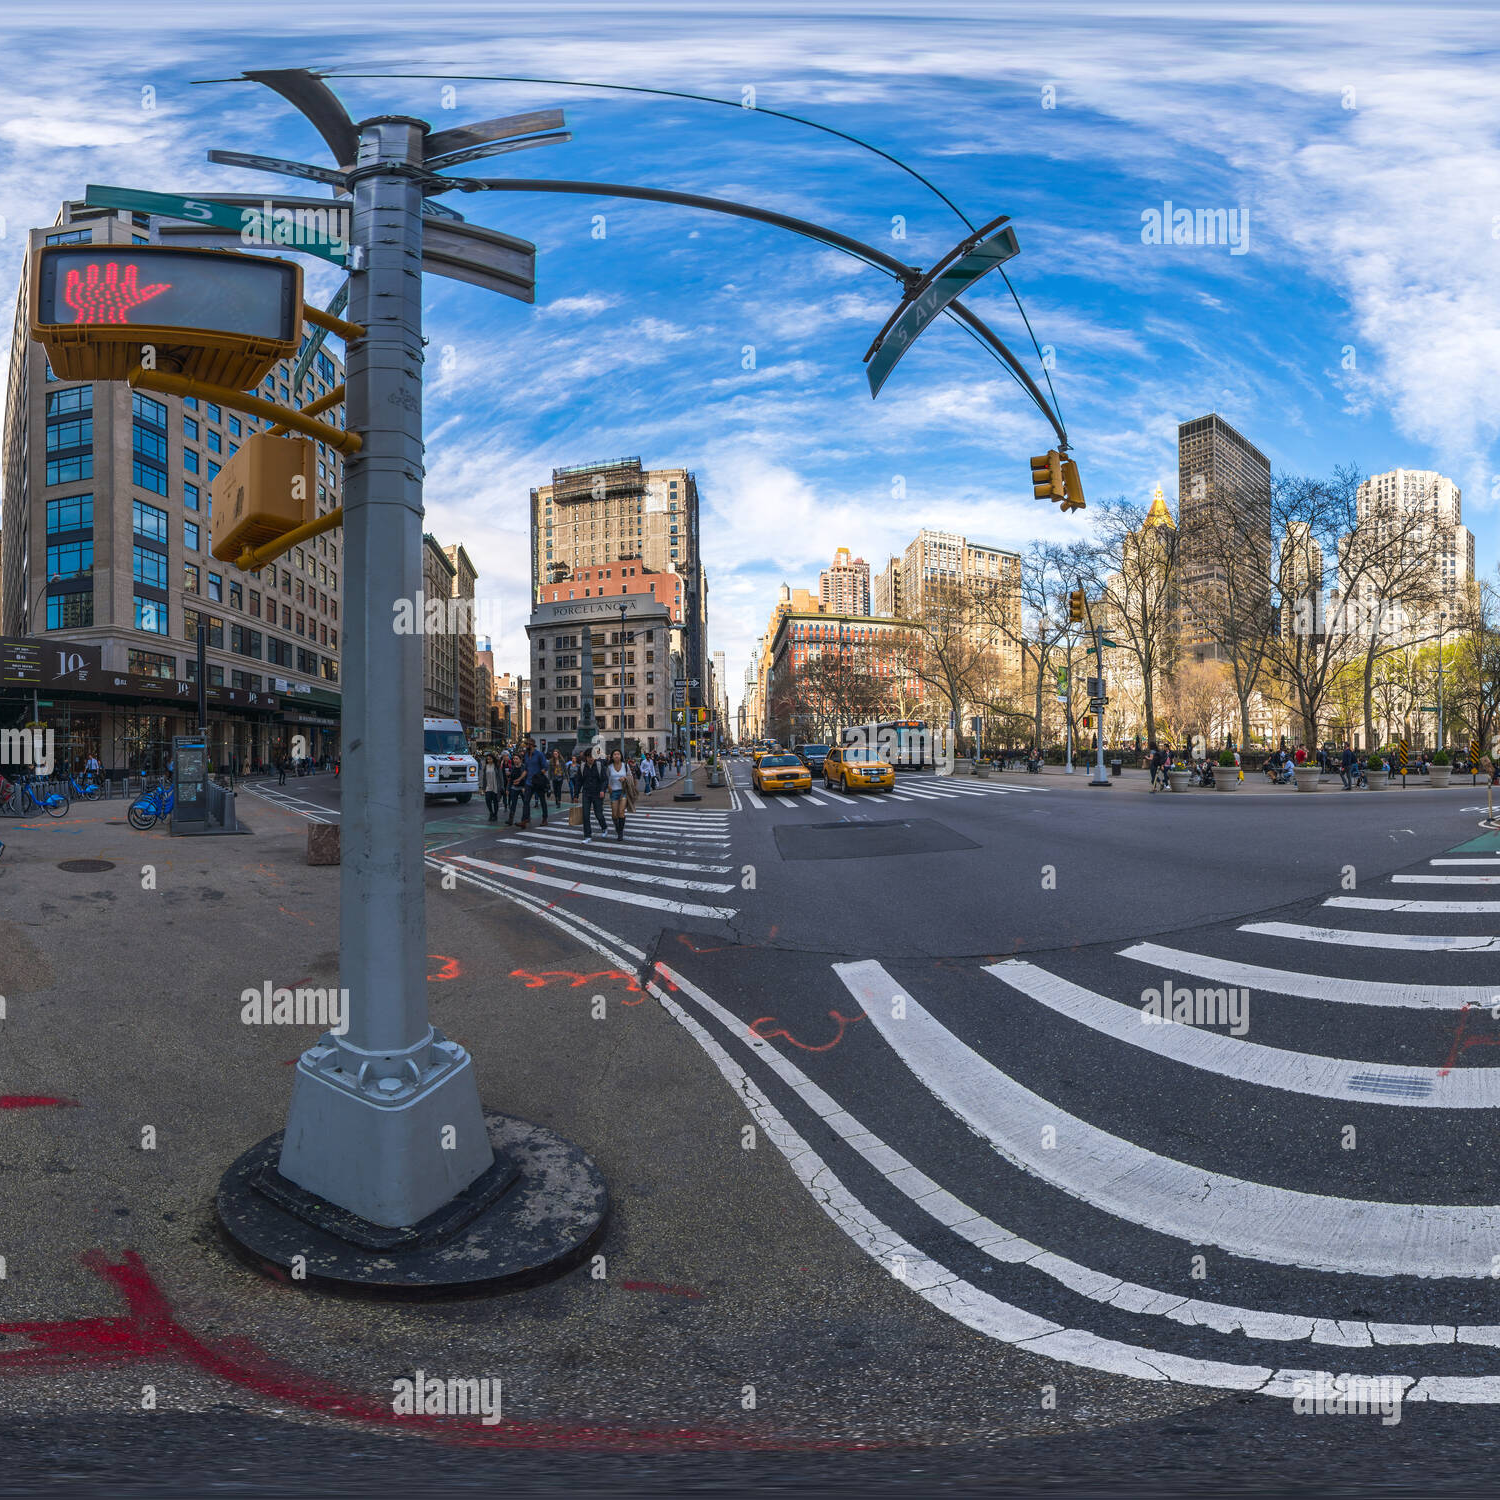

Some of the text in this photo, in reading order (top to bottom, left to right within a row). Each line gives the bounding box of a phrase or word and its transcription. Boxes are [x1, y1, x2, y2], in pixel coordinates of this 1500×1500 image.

[183, 200, 213, 220] 5
[915, 291, 938, 326] AV
[554, 601, 637, 617] PORCELANOA
[55, 651, 85, 676] 10
